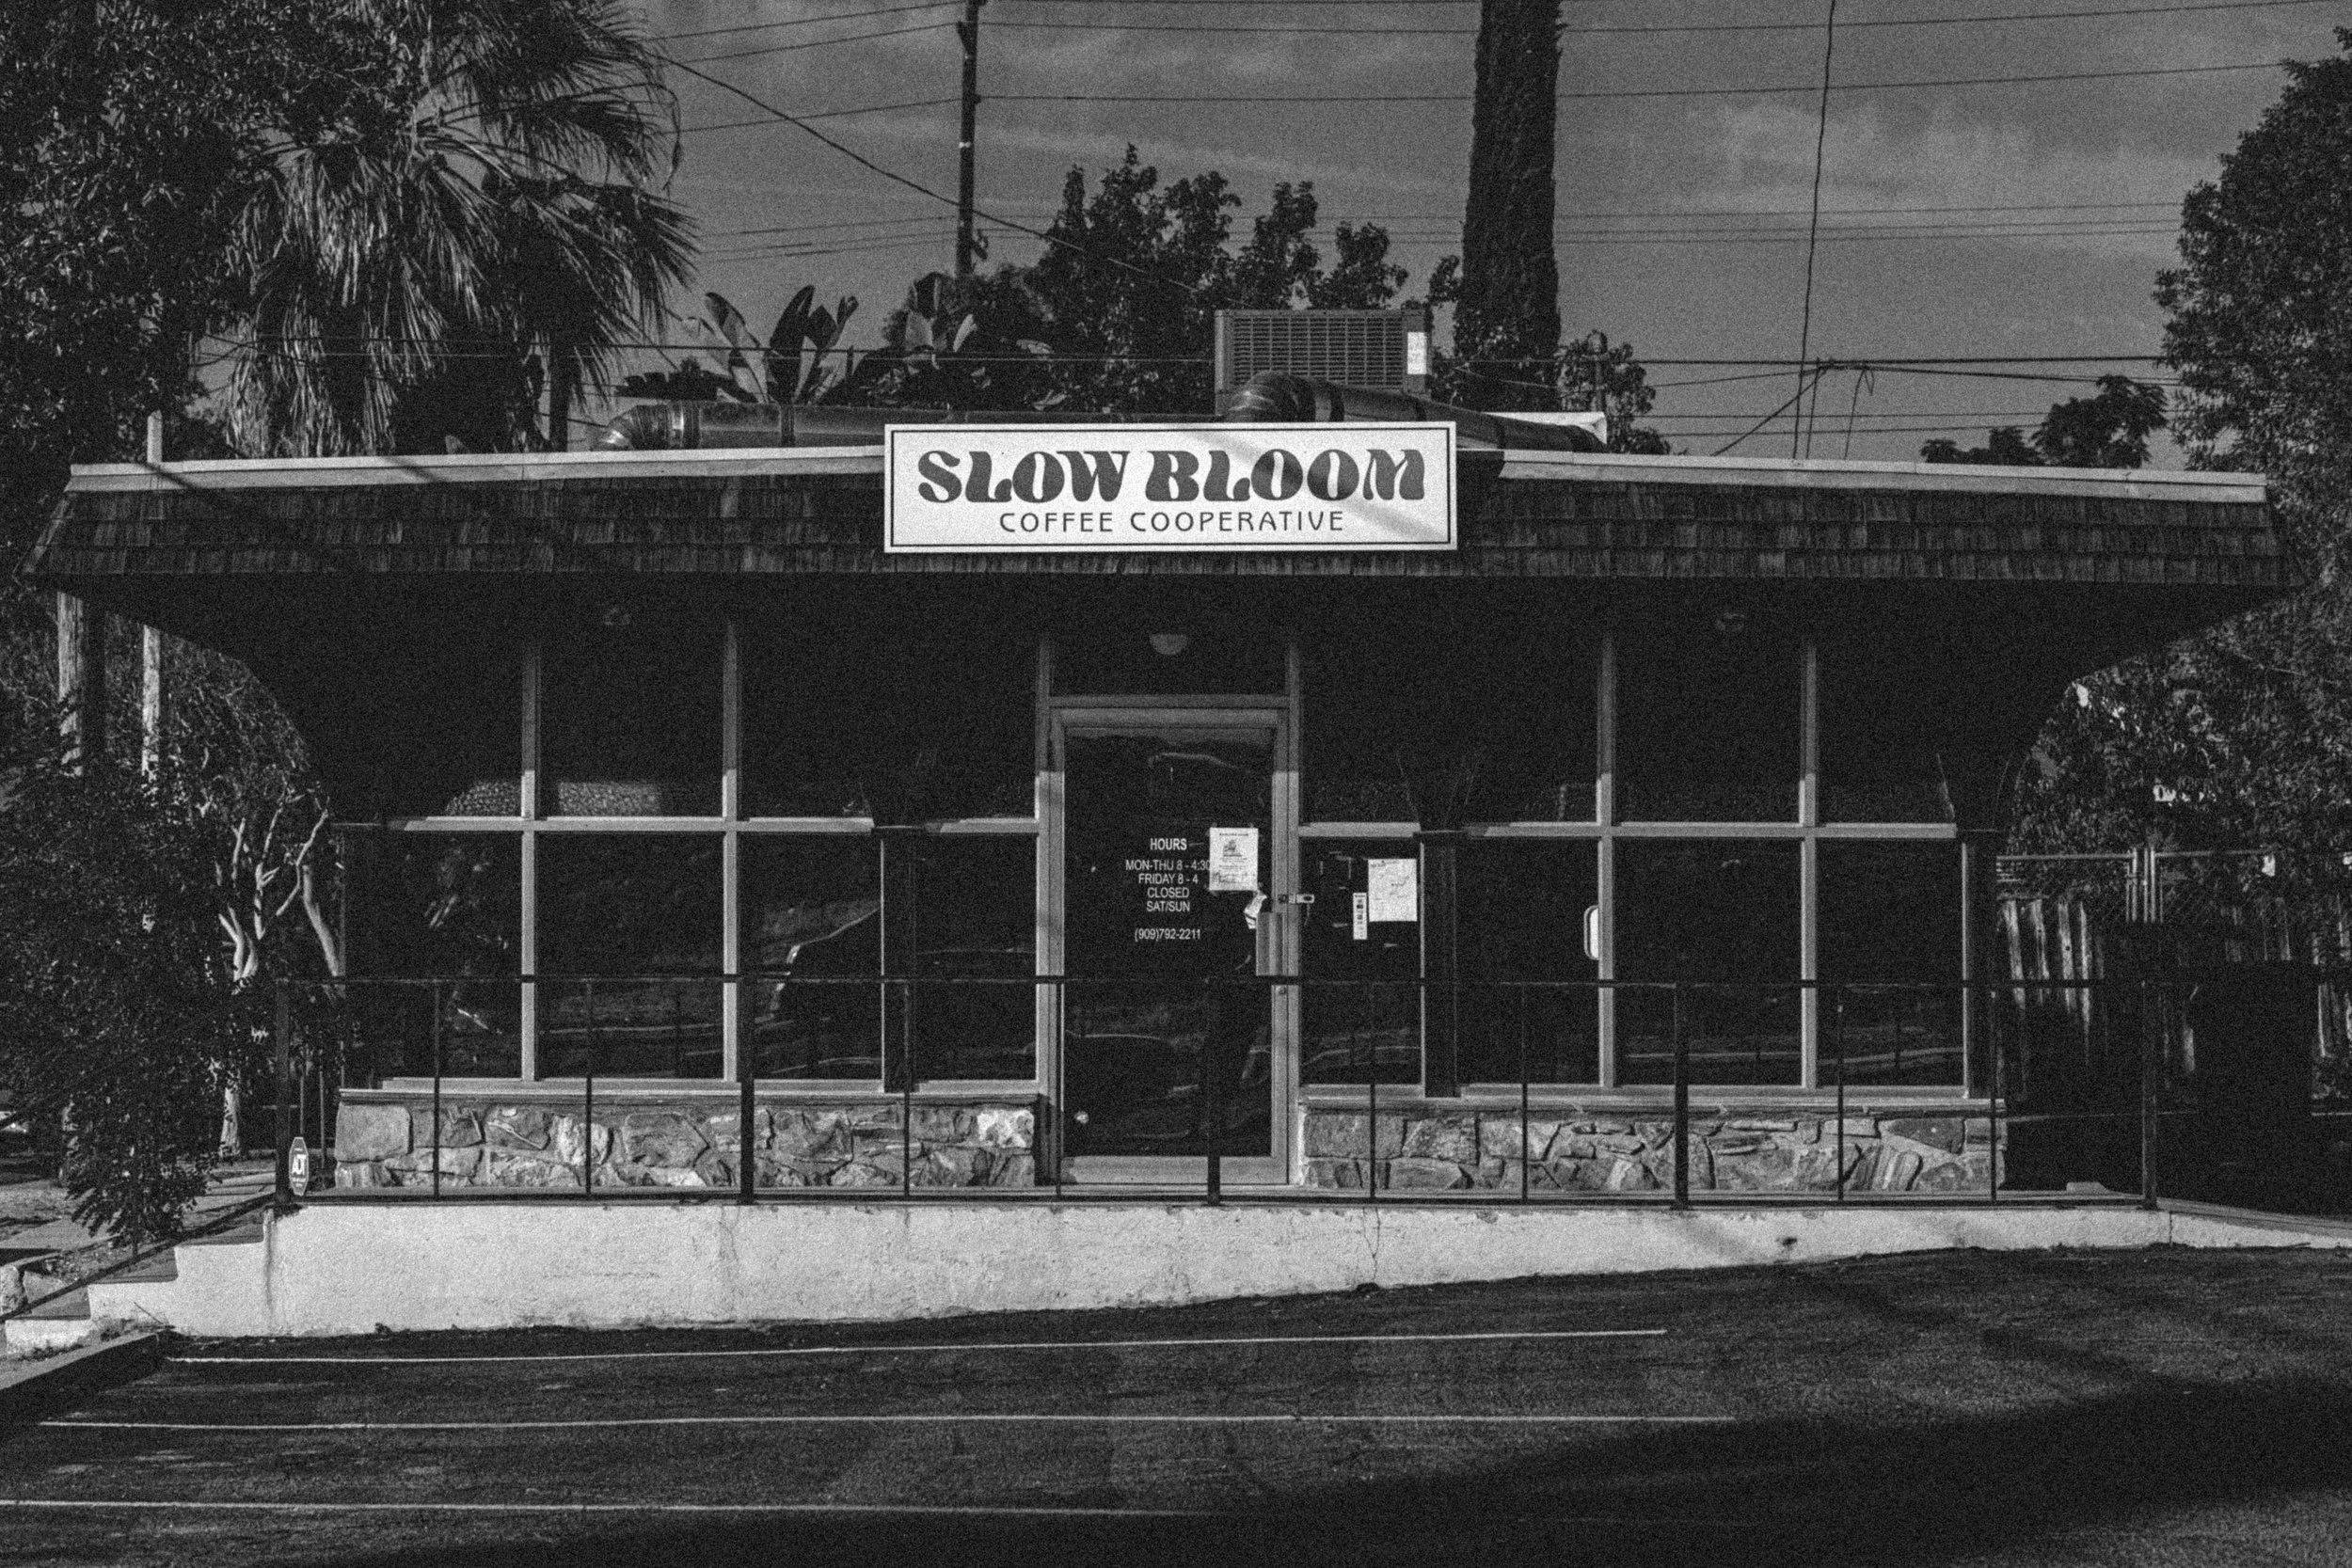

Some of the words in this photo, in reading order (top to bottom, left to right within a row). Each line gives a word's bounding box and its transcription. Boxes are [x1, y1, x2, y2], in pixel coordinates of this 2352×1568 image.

[918, 451, 1130, 503] SLOW
[1145, 449, 1425, 501] BLOOM
[999, 512, 1113, 532] COFFEE
[1130, 511, 1344, 532] COOPERATIVE
[1150, 837, 1187, 850] HOURS
[1125, 859, 1174, 871] MON-THU
[1176, 859, 1184, 871] 8
[1138, 873, 1175, 884] FRIDAY
[1177, 873, 1184, 884] 8
[1192, 874, 1199, 884] 4
[1147, 887, 1190, 898] CLOSED
[1146, 900, 1190, 912] SAT/SUN
[1134, 927, 1201, 942] (909)792-2211
